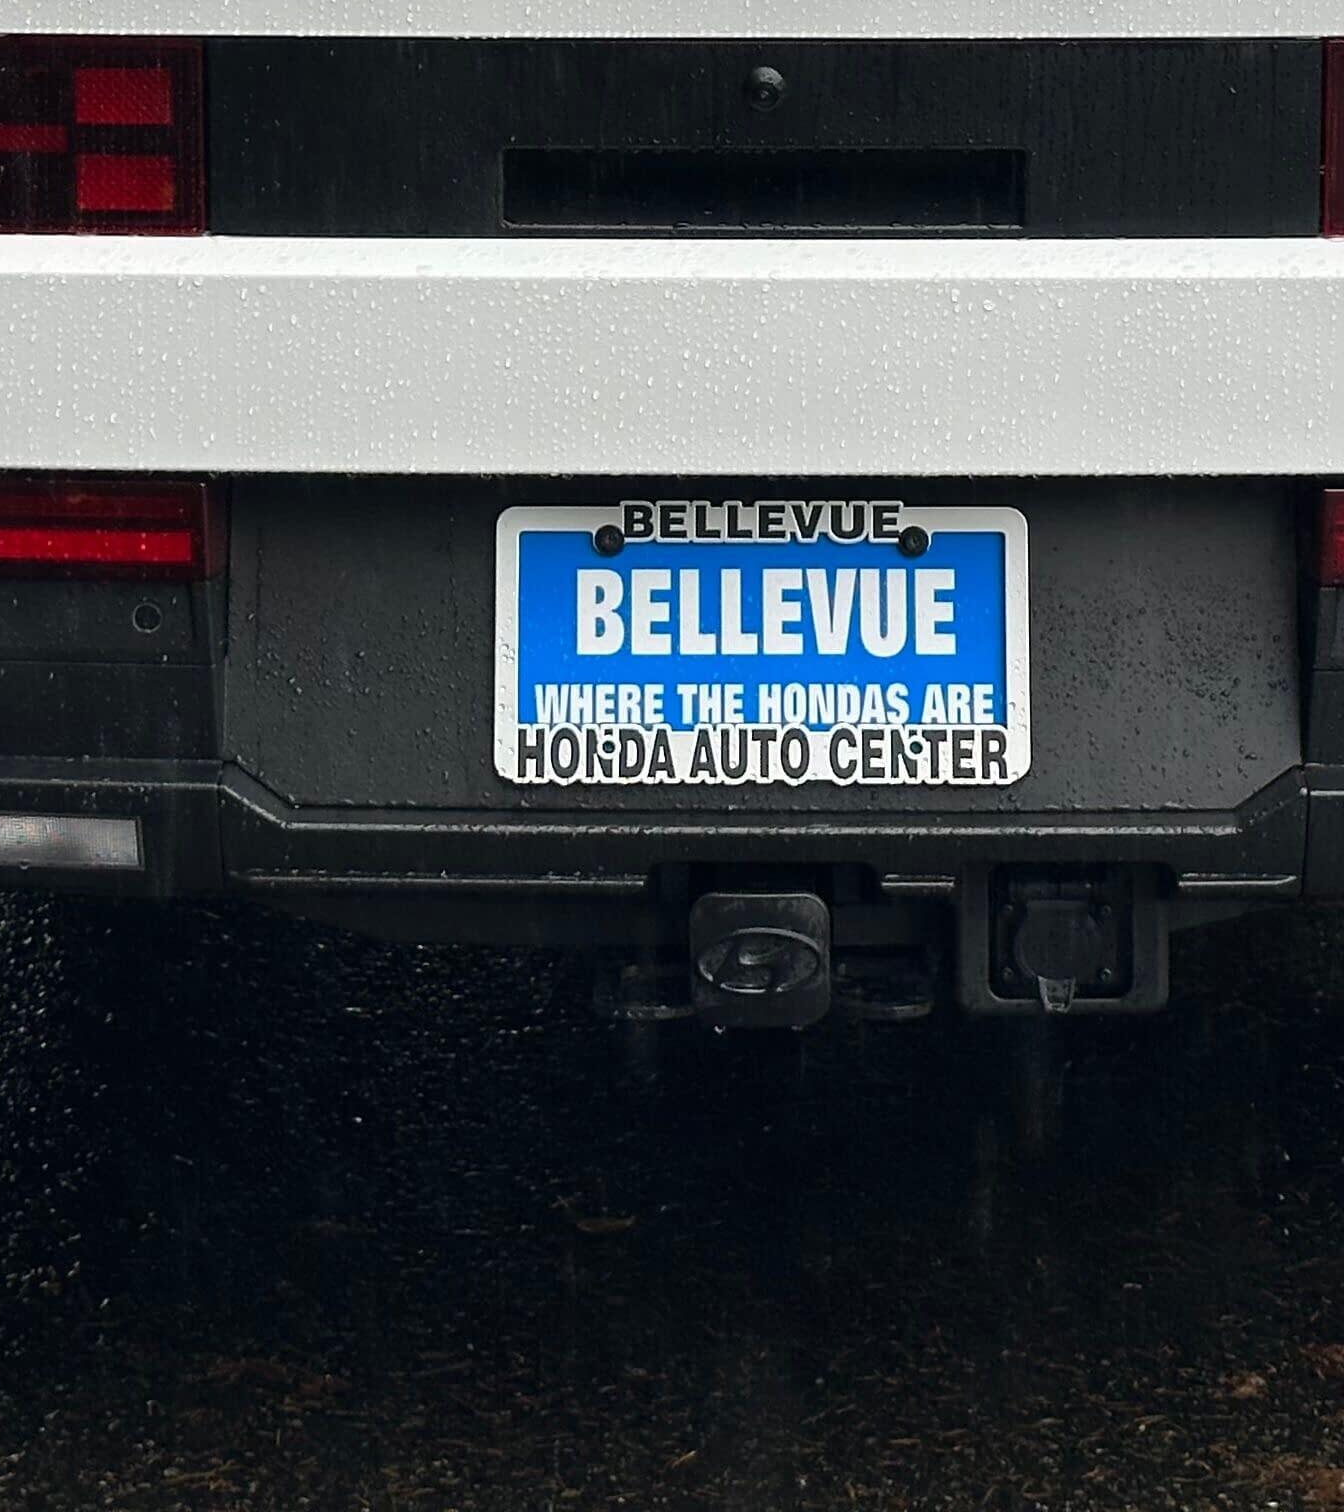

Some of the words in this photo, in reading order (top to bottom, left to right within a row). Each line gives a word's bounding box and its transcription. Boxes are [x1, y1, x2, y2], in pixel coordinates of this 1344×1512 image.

[622, 503, 901, 540] BELLEVUE
[575, 567, 956, 657] BELLEVUE
[534, 683, 664, 725] WHERE
[676, 683, 744, 725] THE
[758, 683, 910, 725] HONDAS
[921, 683, 994, 725] ARE
[517, 728, 678, 780] HONDA
[689, 728, 817, 780] AUTO
[829, 728, 1008, 780] CENTER
